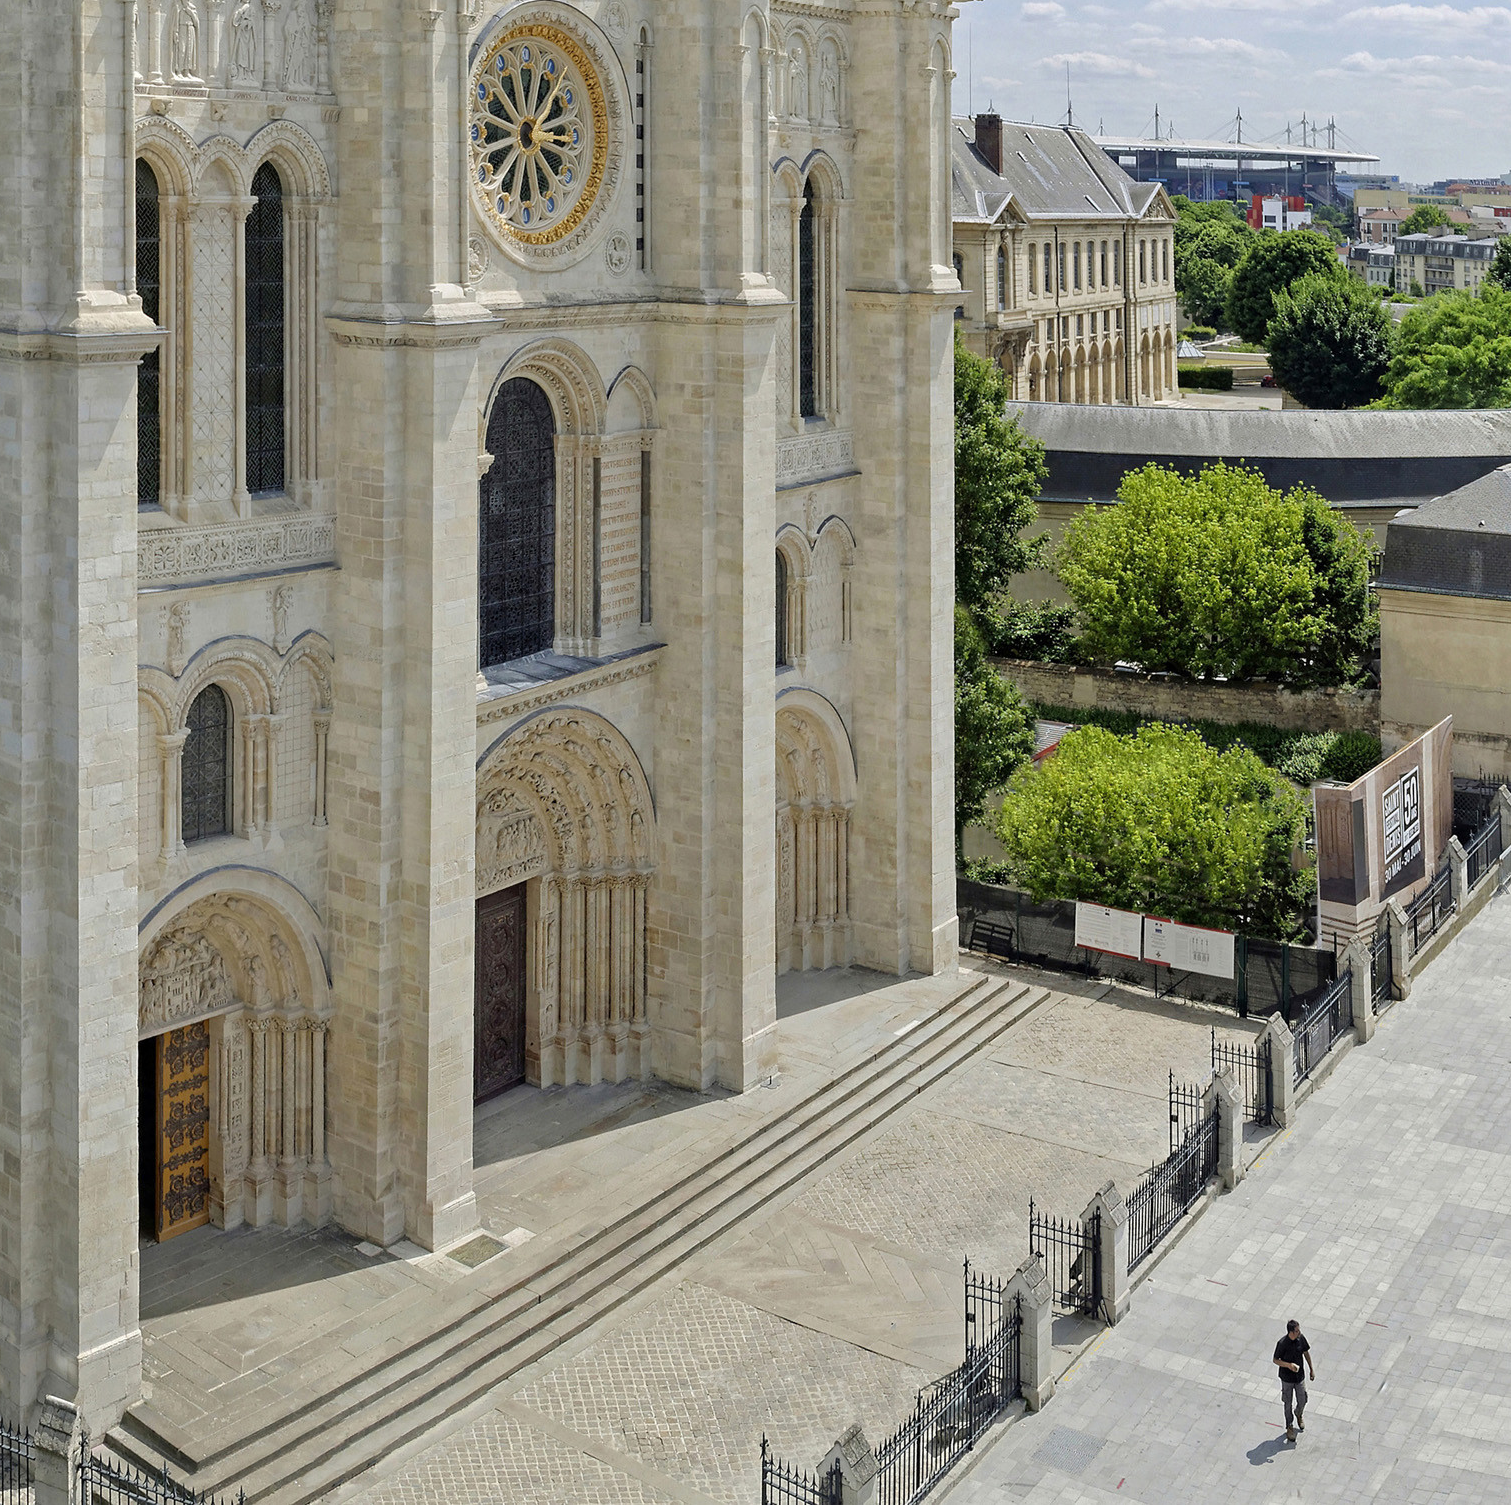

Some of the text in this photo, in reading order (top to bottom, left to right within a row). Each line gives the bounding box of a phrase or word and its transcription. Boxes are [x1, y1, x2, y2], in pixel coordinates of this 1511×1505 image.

[1384, 789, 1400, 817] SAINT
[1404, 776, 1417, 825] 50
[1385, 826, 1401, 856] DENIS
[1391, 857, 1402, 877] MAI
